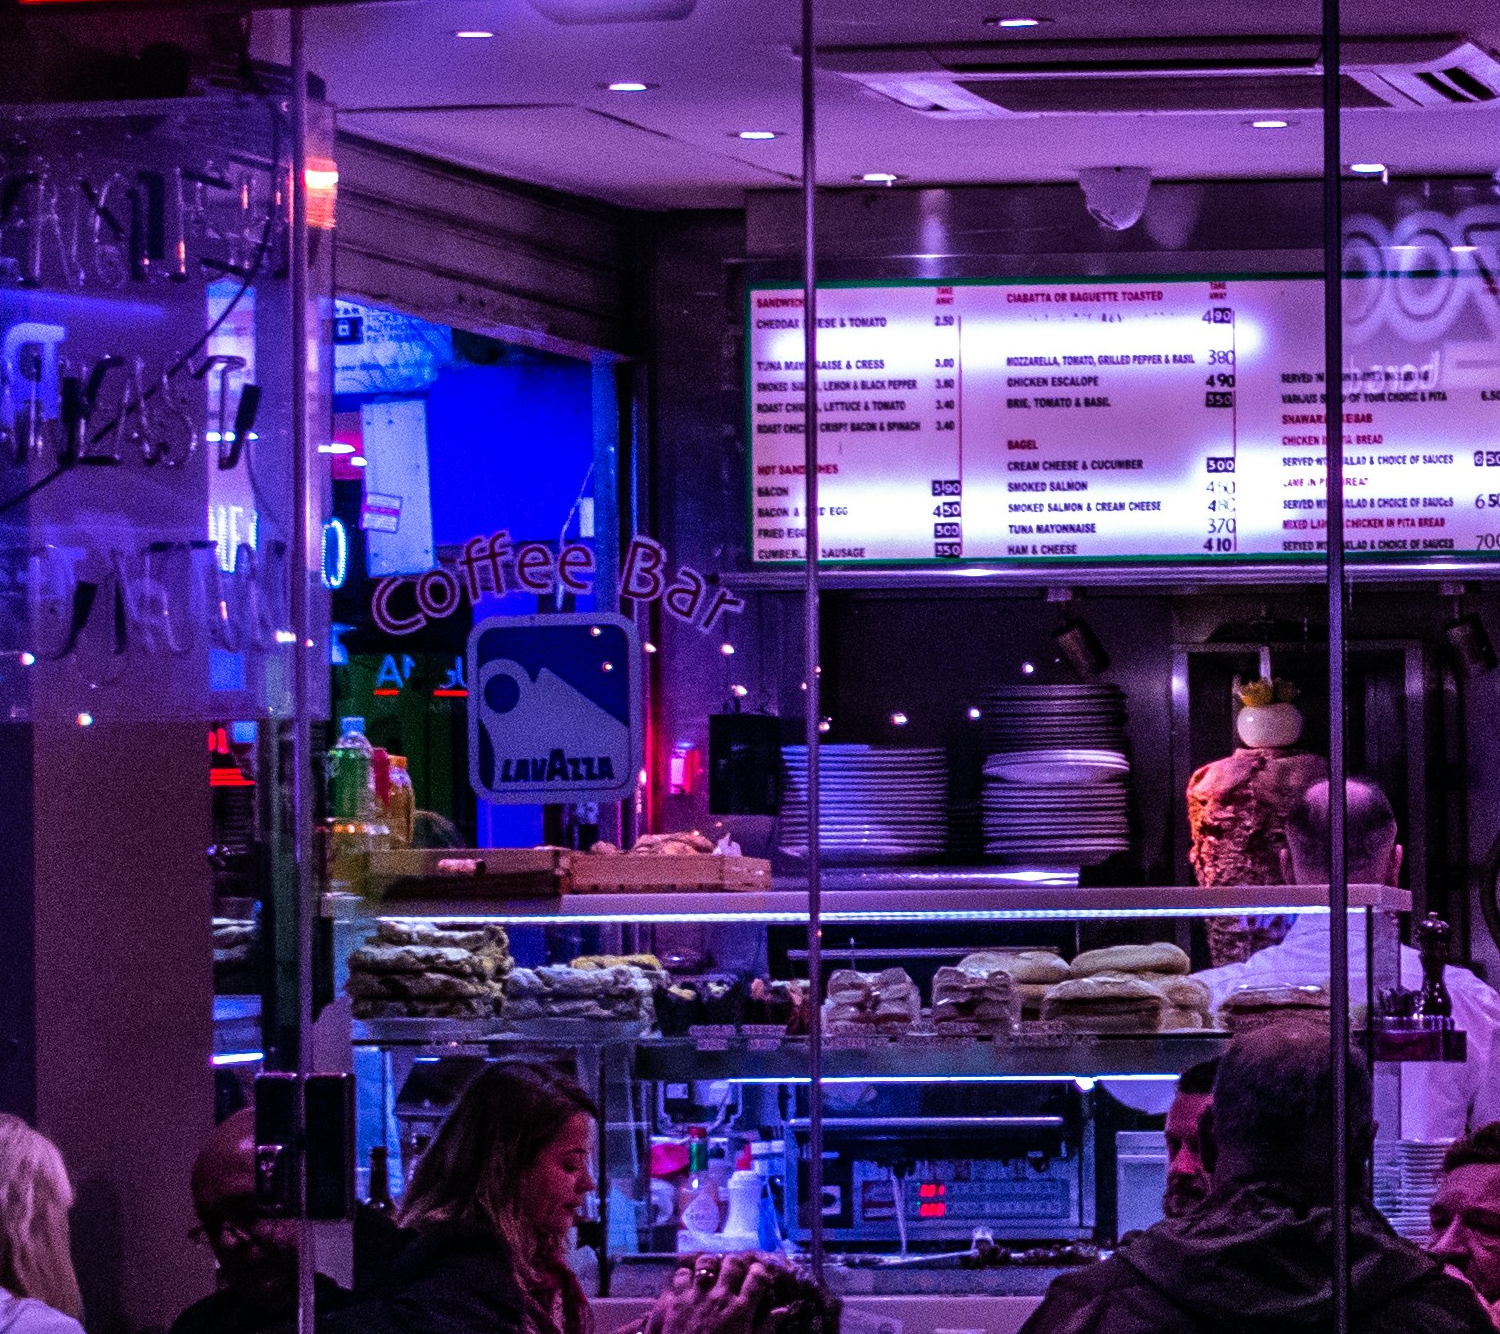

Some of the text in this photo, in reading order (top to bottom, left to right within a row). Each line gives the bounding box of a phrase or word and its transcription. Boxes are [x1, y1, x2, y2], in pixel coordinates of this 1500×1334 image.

[757, 298, 806, 309] SANDWICH
[1007, 291, 1163, 304] CIABATTA OR BAGUETTE TOASTED
[849, 317, 887, 328] TOMATO
[934, 316, 954, 327] 2.50
[935, 358, 954, 369] 3.00
[1007, 356, 1060, 367] MOZZARELLA,
[1063, 356, 1096, 367] TOMATO,
[1098, 355, 1131, 366] GRILLED
[1132, 355, 1163, 365] PEPPER
[1172, 354, 1195, 365] BASIL
[1208, 350, 1235, 365] 380
[756, 361, 782, 371] TUNA
[855, 359, 885, 370] CRESS
[1007, 376, 1099, 388] CHICKEN ESCALOPE
[1206, 373, 1235, 388] 490
[1281, 373, 1313, 383] SERVED
[824, 381, 851, 391] LEMON
[860, 380, 886, 391] BLACK
[887, 379, 918, 390] PEPPER
[1364, 392, 1386, 403] YOUR
[1388, 392, 1418, 402] CHOICE
[1481, 390, 1500, 401] 6.50
[756, 403, 784, 413] ROAST
[824, 401, 861, 412] LETTUCE
[872, 400, 906, 411] TOMATO
[935, 400, 955, 411] 3.40
[1007, 398, 1031, 409] BRIE,
[1034, 398, 1072, 408] TOMATO
[1084, 397, 1110, 408] BASIL
[1282, 413, 1327, 424] SHAWAR
[850, 422, 877, 433] BACON
[886, 422, 920, 432] SPINACH
[1007, 440, 1038, 450] BAGEL
[1282, 435, 1320, 445] CHICKEN
[1356, 434, 1383, 444] BREAD
[1007, 461, 1039, 471] CREAM
[1042, 460, 1078, 471] CHEESE
[1091, 459, 1143, 470] CUCUMBER
[1282, 457, 1314, 467] SERVED
[1342, 456, 1366, 466] ALAD
[1377, 455, 1407, 465] CHOICE
[1410, 455, 1420, 464] OF
[1422, 455, 1454, 464] SAUCES
[757, 465, 776, 476] HOT
[757, 487, 789, 497] BACON
[1007, 481, 1088, 492] SMOKED SALMON
[1007, 503, 1044, 513] SMOKED
[1047, 502, 1083, 512] SALMON
[1095, 501, 1126, 512] CREAM
[1128, 501, 1161, 511] CHEESE
[1283, 499, 1314, 509] SERVED
[1342, 498, 1367, 508] ALAD
[1377, 498, 1407, 507] CHOICE
[1410, 498, 1420, 507] OF
[1423, 497, 1454, 507] SAUCES
[757, 507, 790, 518] BACON
[830, 507, 848, 516] EGG
[933, 502, 961, 517] 450
[1008, 523, 1096, 535] TUNA MAYONNAISE
[1208, 518, 1235, 534] 370
[1283, 517, 1445, 529] MIXED CHICKEN IN PITA BREAD
[757, 528, 807, 539] FRIED EGG
[1007, 545, 1028, 555] HAM
[1041, 544, 1077, 554] CHEESE
[1204, 538, 1231, 552] 410
[1283, 541, 1314, 551] SERVED
[1343, 540, 1367, 550] ALAD
[1378, 540, 1407, 550] CHOICE
[1410, 540, 1420, 549] OF
[1422, 539, 1454, 549] SAUCES
[821, 548, 866, 558] SAUSAGE
[372, 531, 596, 635] Coffee
[621, 534, 745, 633] Bar
[501, 749, 615, 782] LAVAZZA
